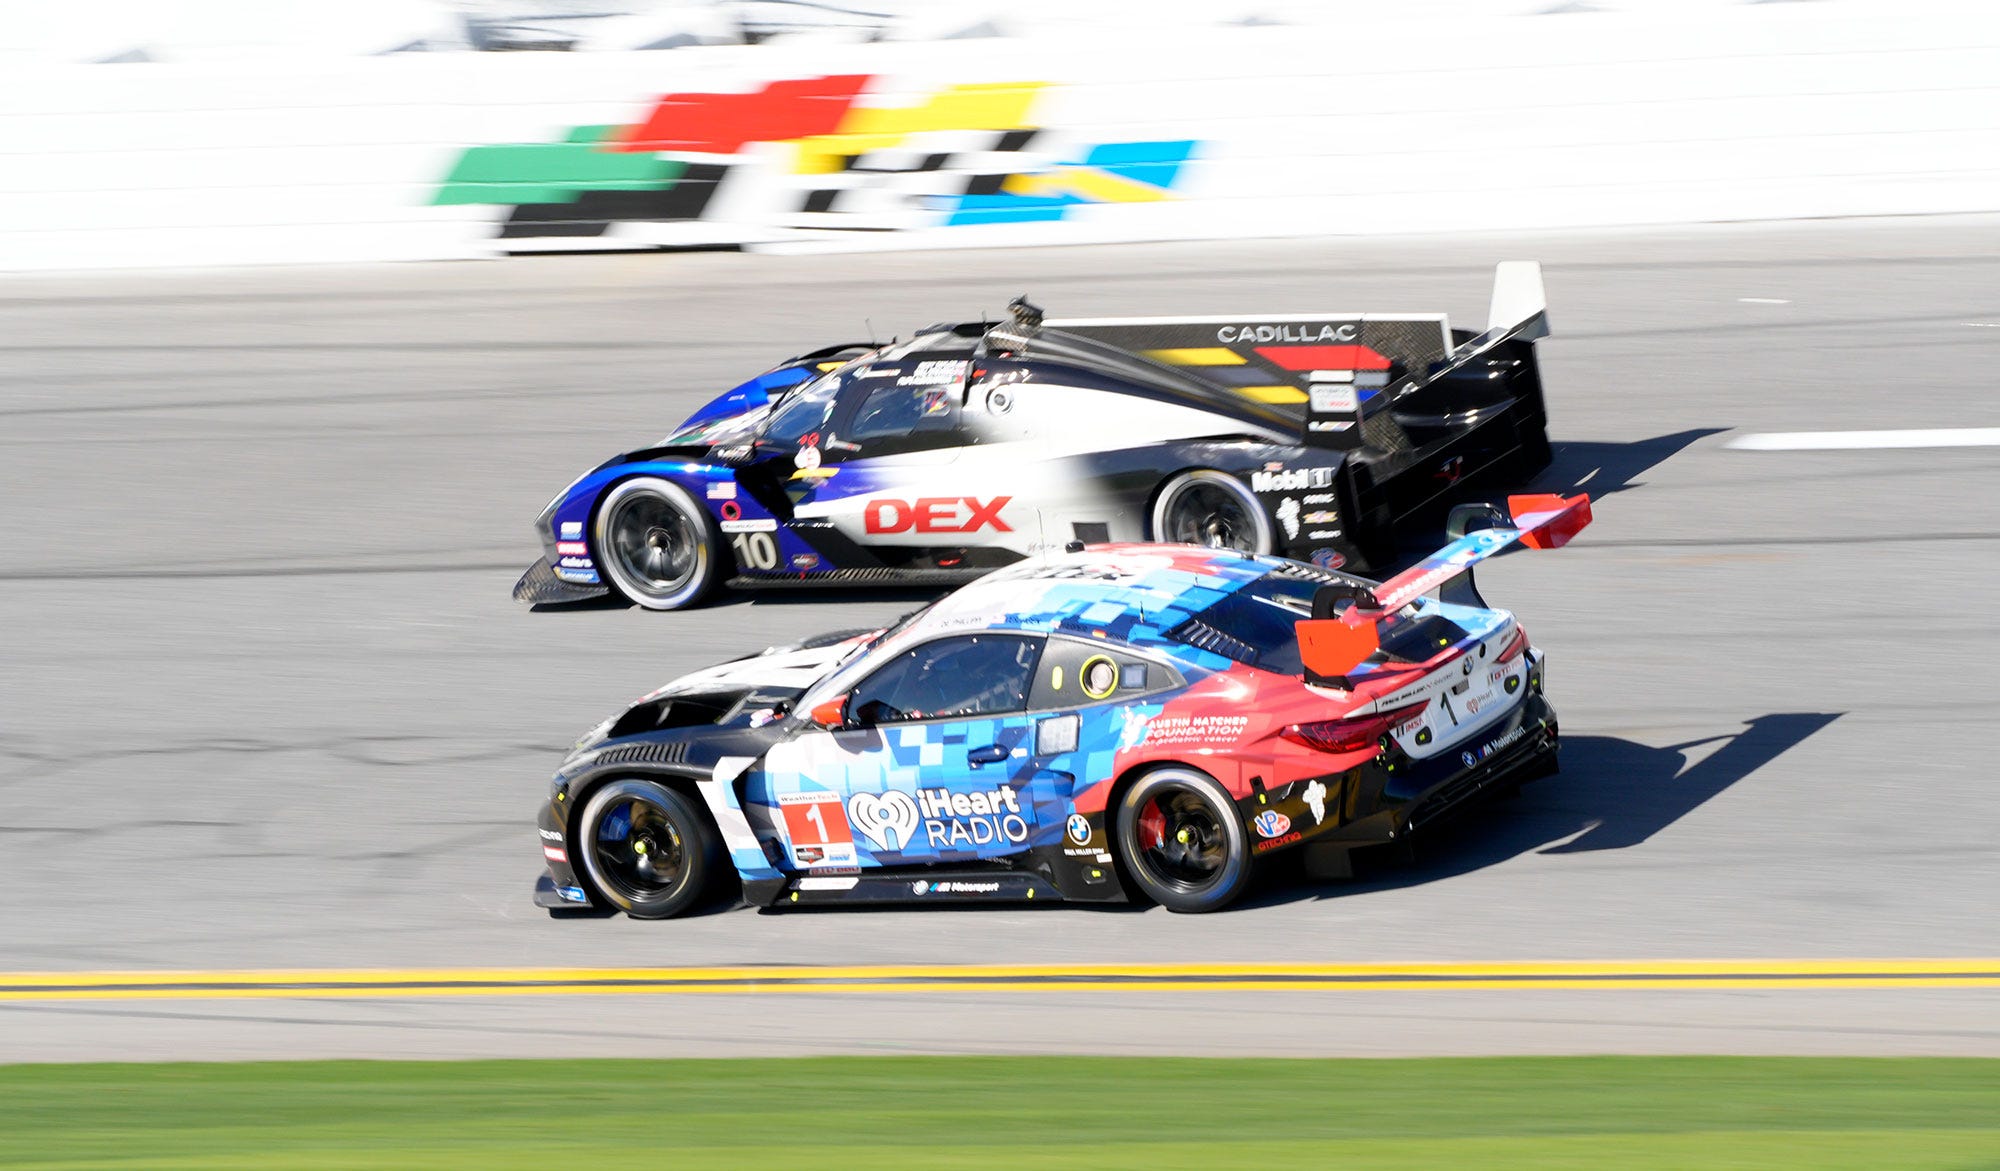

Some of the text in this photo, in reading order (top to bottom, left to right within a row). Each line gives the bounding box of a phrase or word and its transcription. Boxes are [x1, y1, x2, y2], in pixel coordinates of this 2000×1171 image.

[1217, 324, 1357, 343] CADILLAC
[1251, 470, 1309, 493] Mobil
[864, 496, 1014, 534] DEX
[733, 532, 777, 568] 10
[1148, 716, 1248, 729] AUSTIN HATCHER
[1440, 691, 1458, 726] 1
[1146, 725, 1243, 741] FOUNDATION
[916, 785, 1021, 819] iHeart
[806, 803, 829, 843] 1
[925, 814, 1028, 848] RADIO
[1254, 810, 1278, 836] VP
[951, 882, 999, 893] Motorsport
